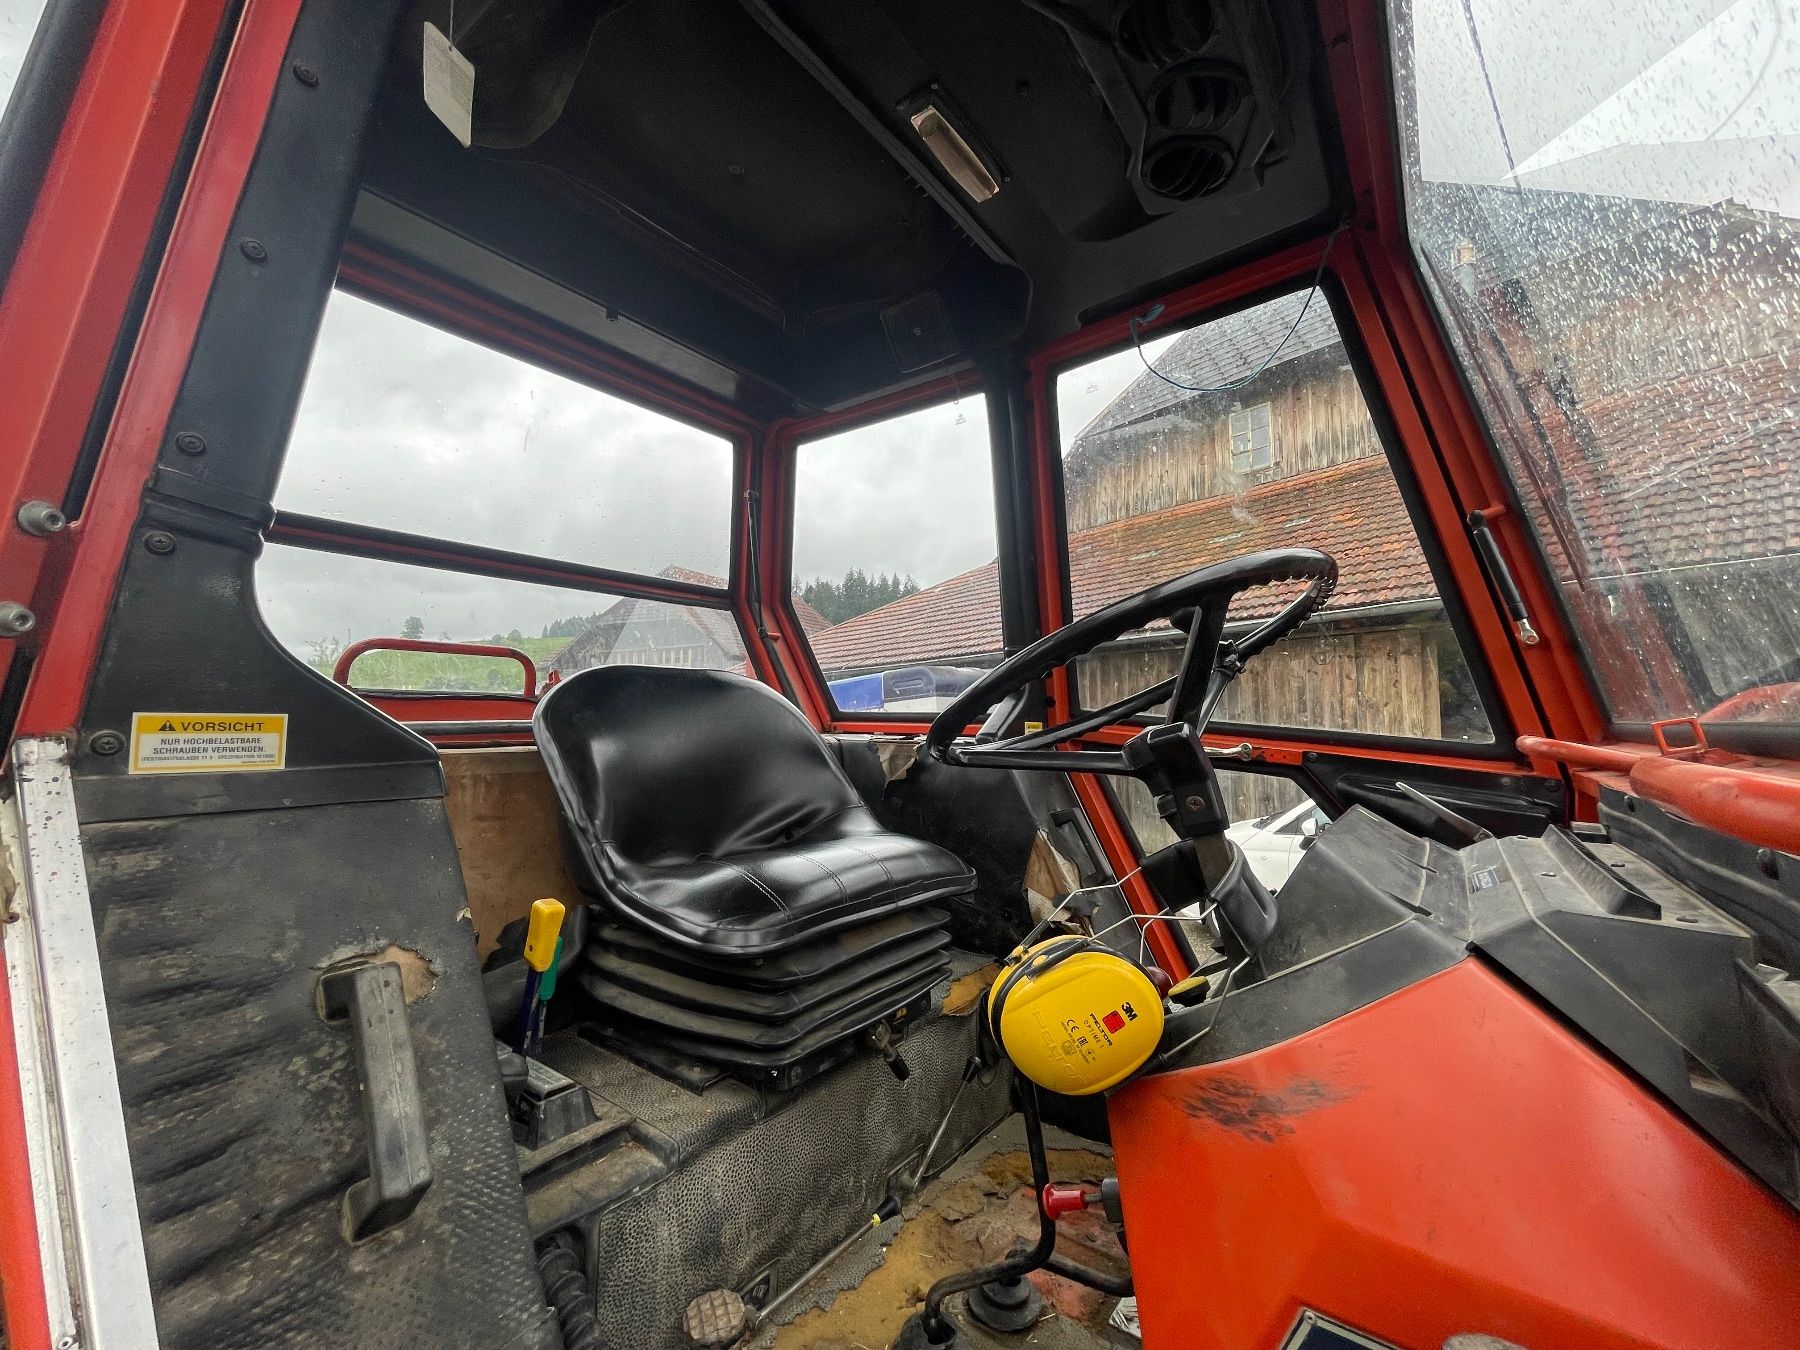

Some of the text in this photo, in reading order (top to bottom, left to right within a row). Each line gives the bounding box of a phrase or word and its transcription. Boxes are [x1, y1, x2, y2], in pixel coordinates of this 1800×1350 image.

[181, 721, 265, 732] VORSICHT
[183, 737, 261, 745] HOCHBELASTBARE
[153, 747, 209, 755] SCHRAUBEN
[1121, 1002, 1138, 1021] 3M
[1083, 1019, 1101, 1045] OPTIME
[1089, 1013, 1113, 1047] PELTOR
